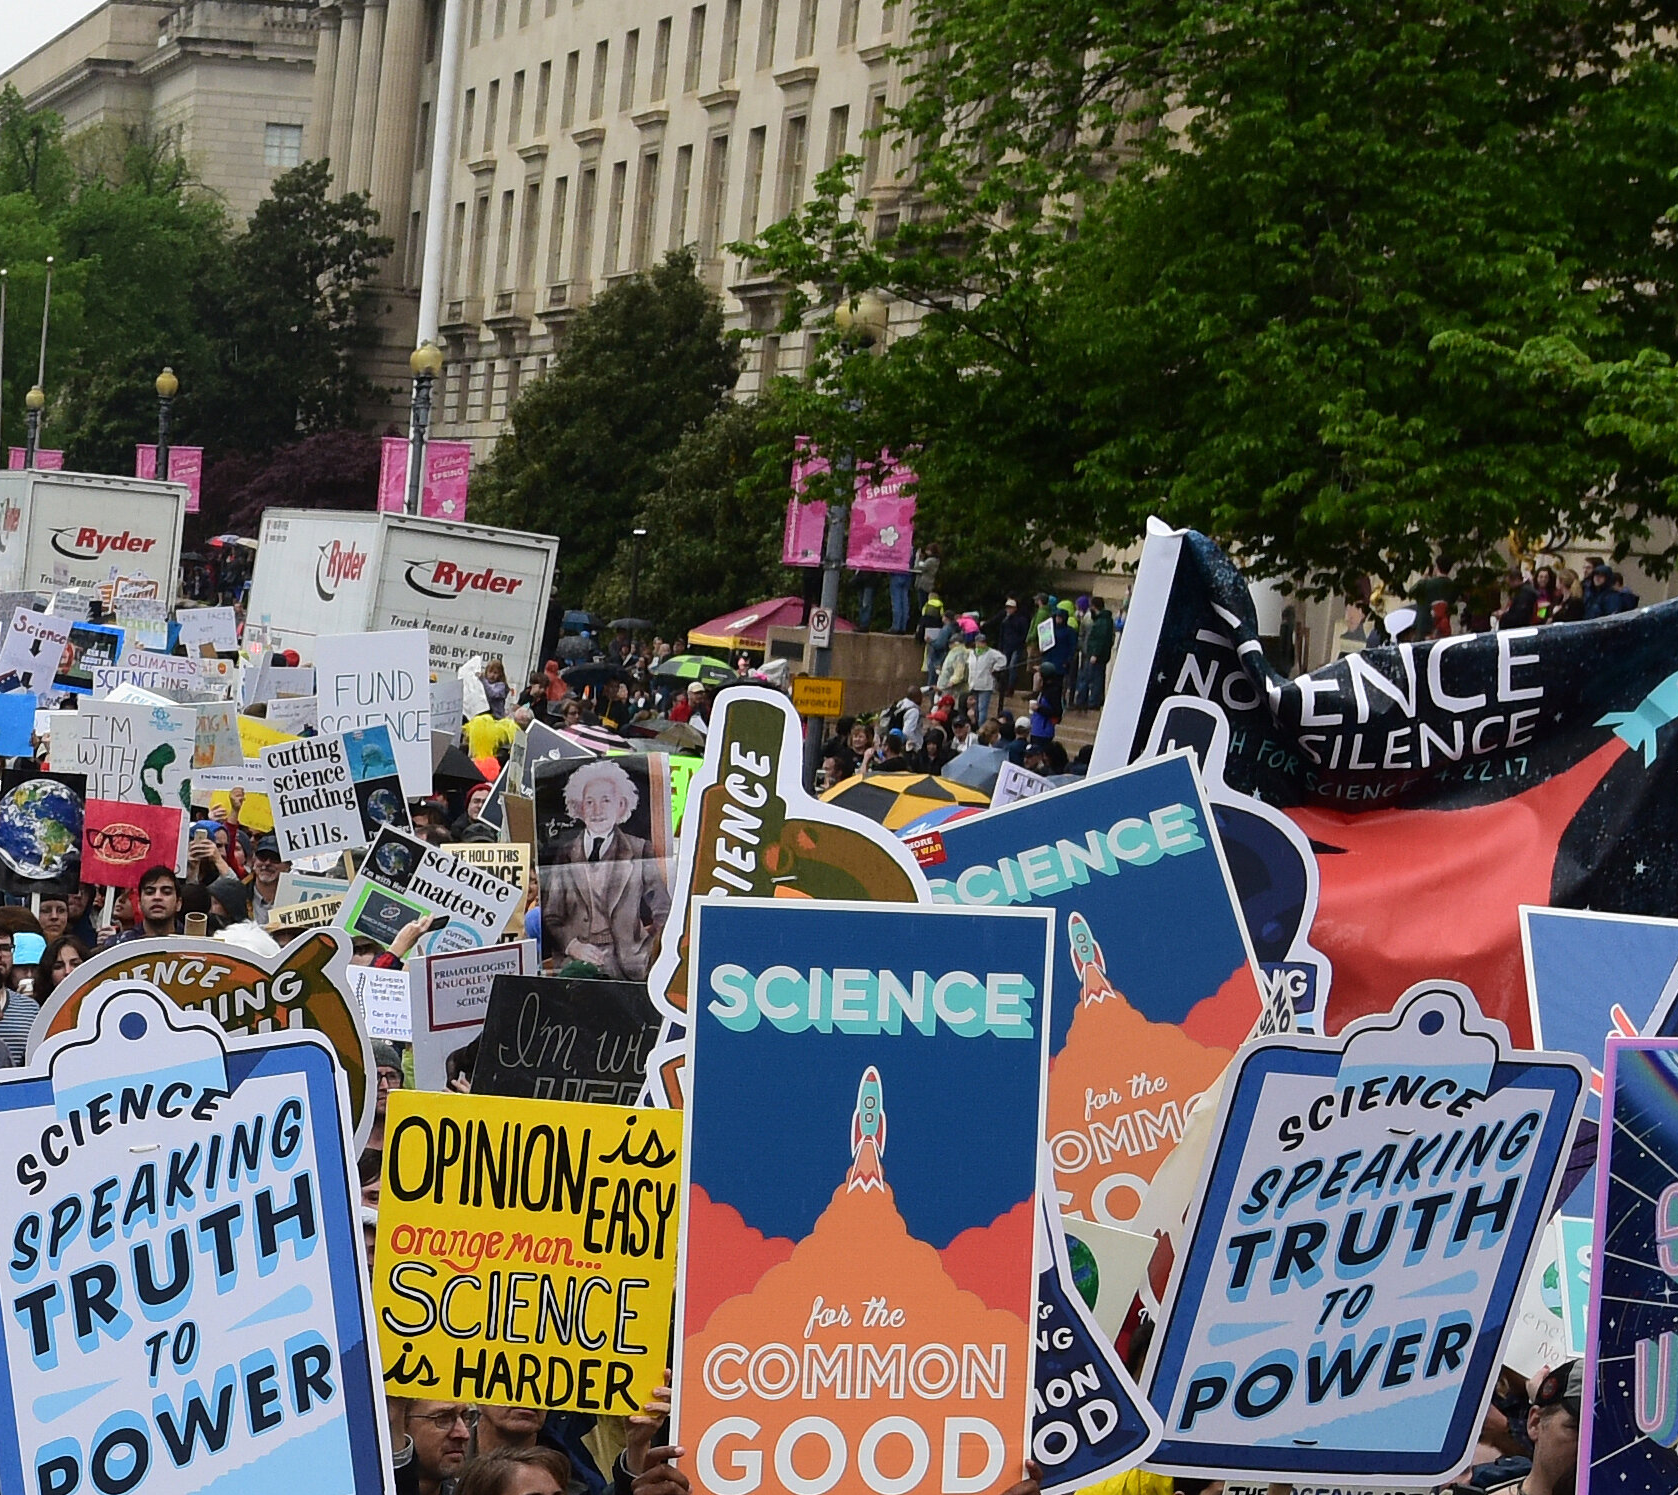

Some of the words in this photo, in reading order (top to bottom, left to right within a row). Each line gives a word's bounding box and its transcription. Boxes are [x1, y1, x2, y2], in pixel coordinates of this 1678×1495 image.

[75, 527, 155, 554] Ryder
[328, 539, 366, 580] Ryder
[433, 561, 522, 597] Ryder
[391, 615, 419, 628] Truck
[423, 620, 458, 634] Rental
[461, 626, 469, 636] &
[473, 627, 515, 645] Leasing
[128, 654, 197, 674] CLIMATE'S
[336, 670, 412, 706] FUND
[267, 741, 341, 770] cutting
[1298, 708, 1541, 771] SILENCE
[273, 765, 346, 794] science
[279, 786, 355, 817] funding
[287, 824, 349, 852] kills.
[410, 876, 496, 928] matters
[424, 851, 509, 902] science
[434, 961, 516, 979] PRIMATOLOGISTS
[708, 963, 1032, 1034] SCIENCE
[18, 1084, 231, 1195] SCIENCE
[389, 1115, 591, 1213] OPINION
[600, 1116, 675, 1168] is
[11, 1097, 304, 1274] SPEAKING
[585, 1177, 676, 1260] EASY
[13, 1173, 315, 1357] TRUTH
[383, 1262, 649, 1355] SCIENCE
[805, 1295, 851, 1338] for
[864, 1297, 906, 1329] the
[146, 1320, 198, 1377] TO
[703, 1343, 1007, 1401] COMMON
[383, 1343, 440, 1387] is
[454, 1350, 640, 1412] HARDER
[697, 1417, 1006, 1495] GOOD
